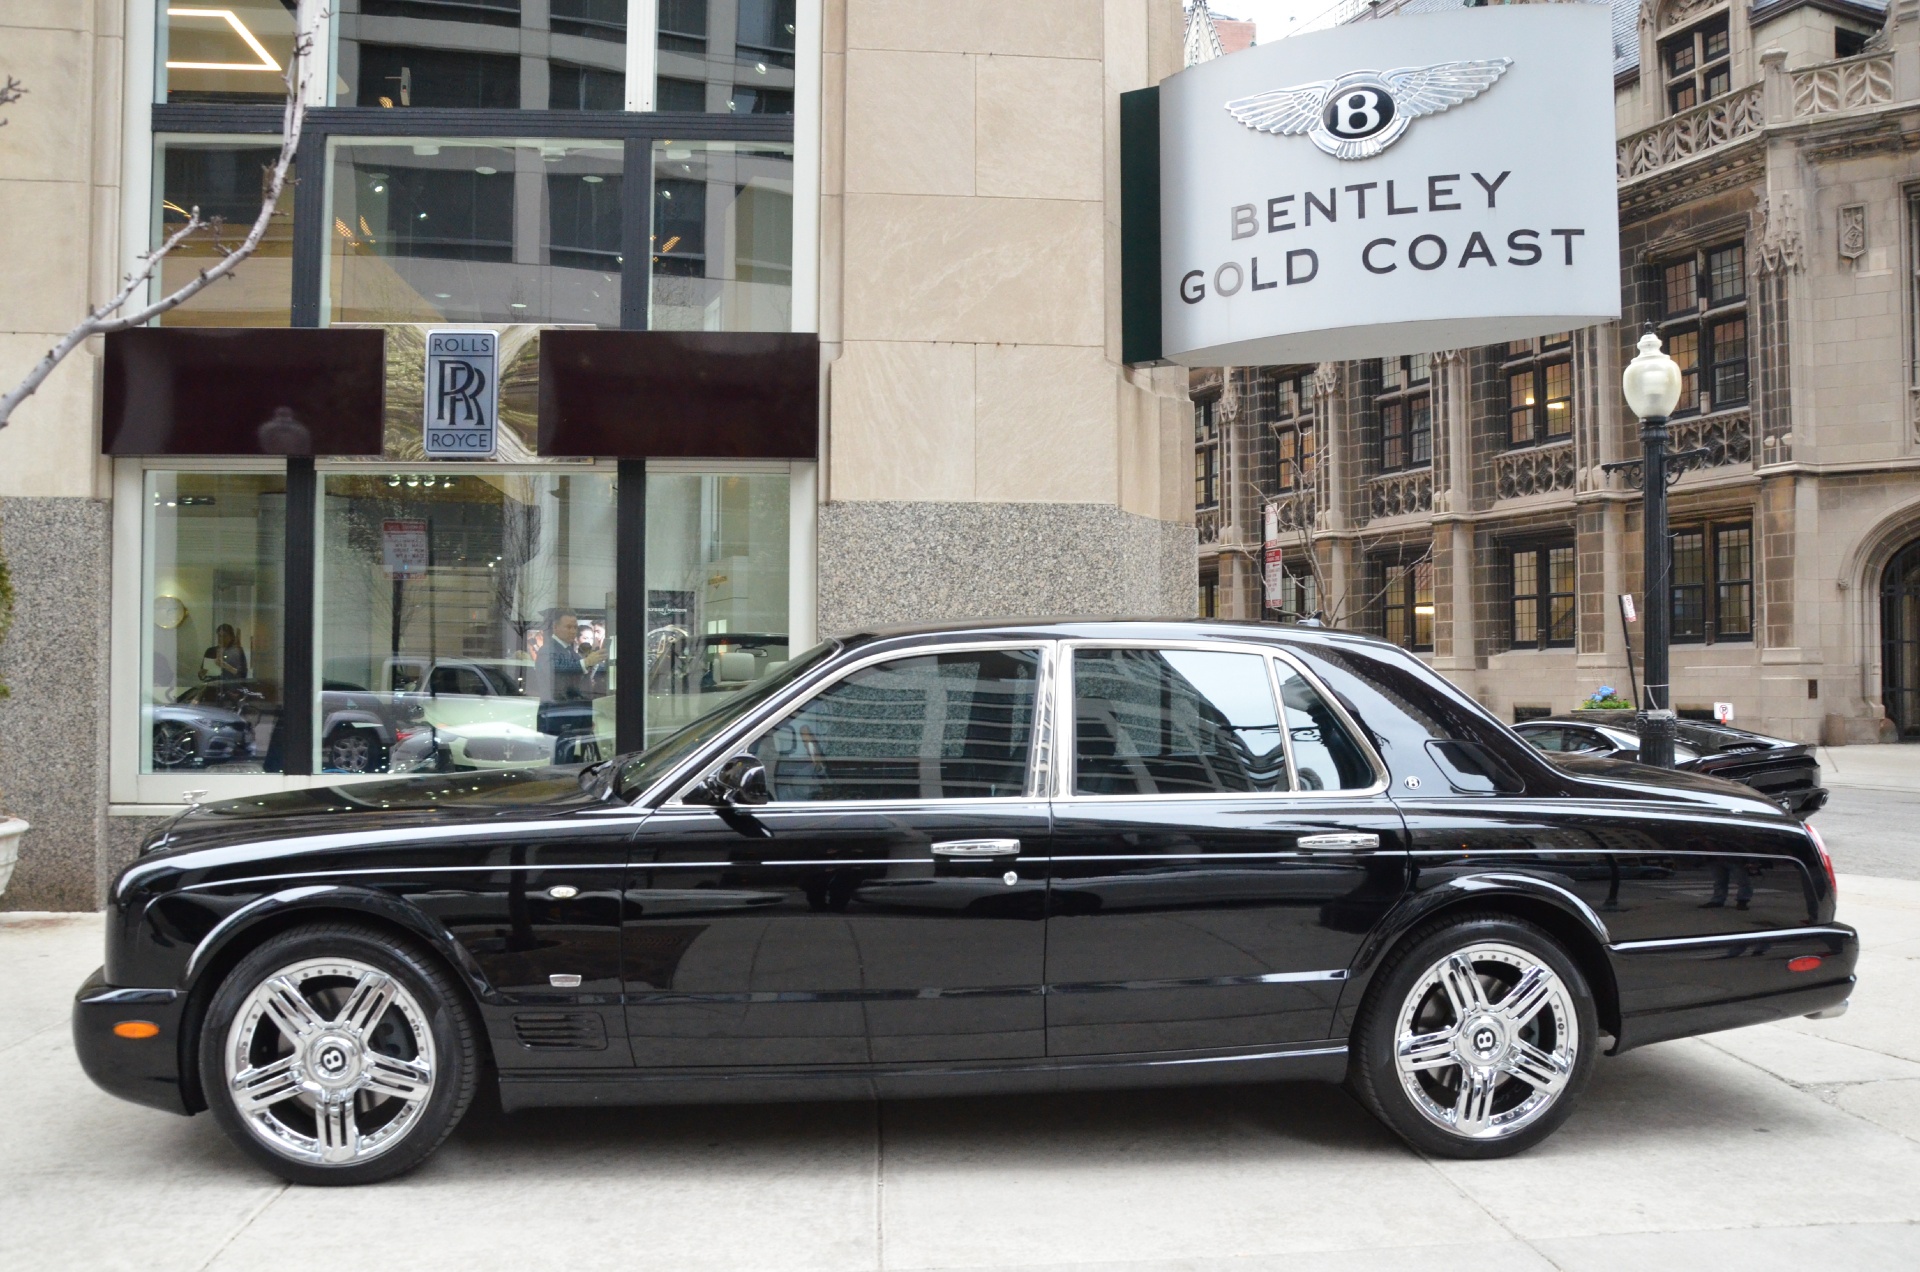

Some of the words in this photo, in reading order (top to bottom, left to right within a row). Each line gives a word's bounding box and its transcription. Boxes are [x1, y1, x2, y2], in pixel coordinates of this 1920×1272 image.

[1231, 170, 1512, 241] BENTLEY
[1180, 248, 1319, 305] GOLD
[1361, 228, 1586, 275] COAST
[433, 338, 490, 352] ROLLS
[436, 359, 486, 426] RR
[431, 433, 488, 448] ROYCE
